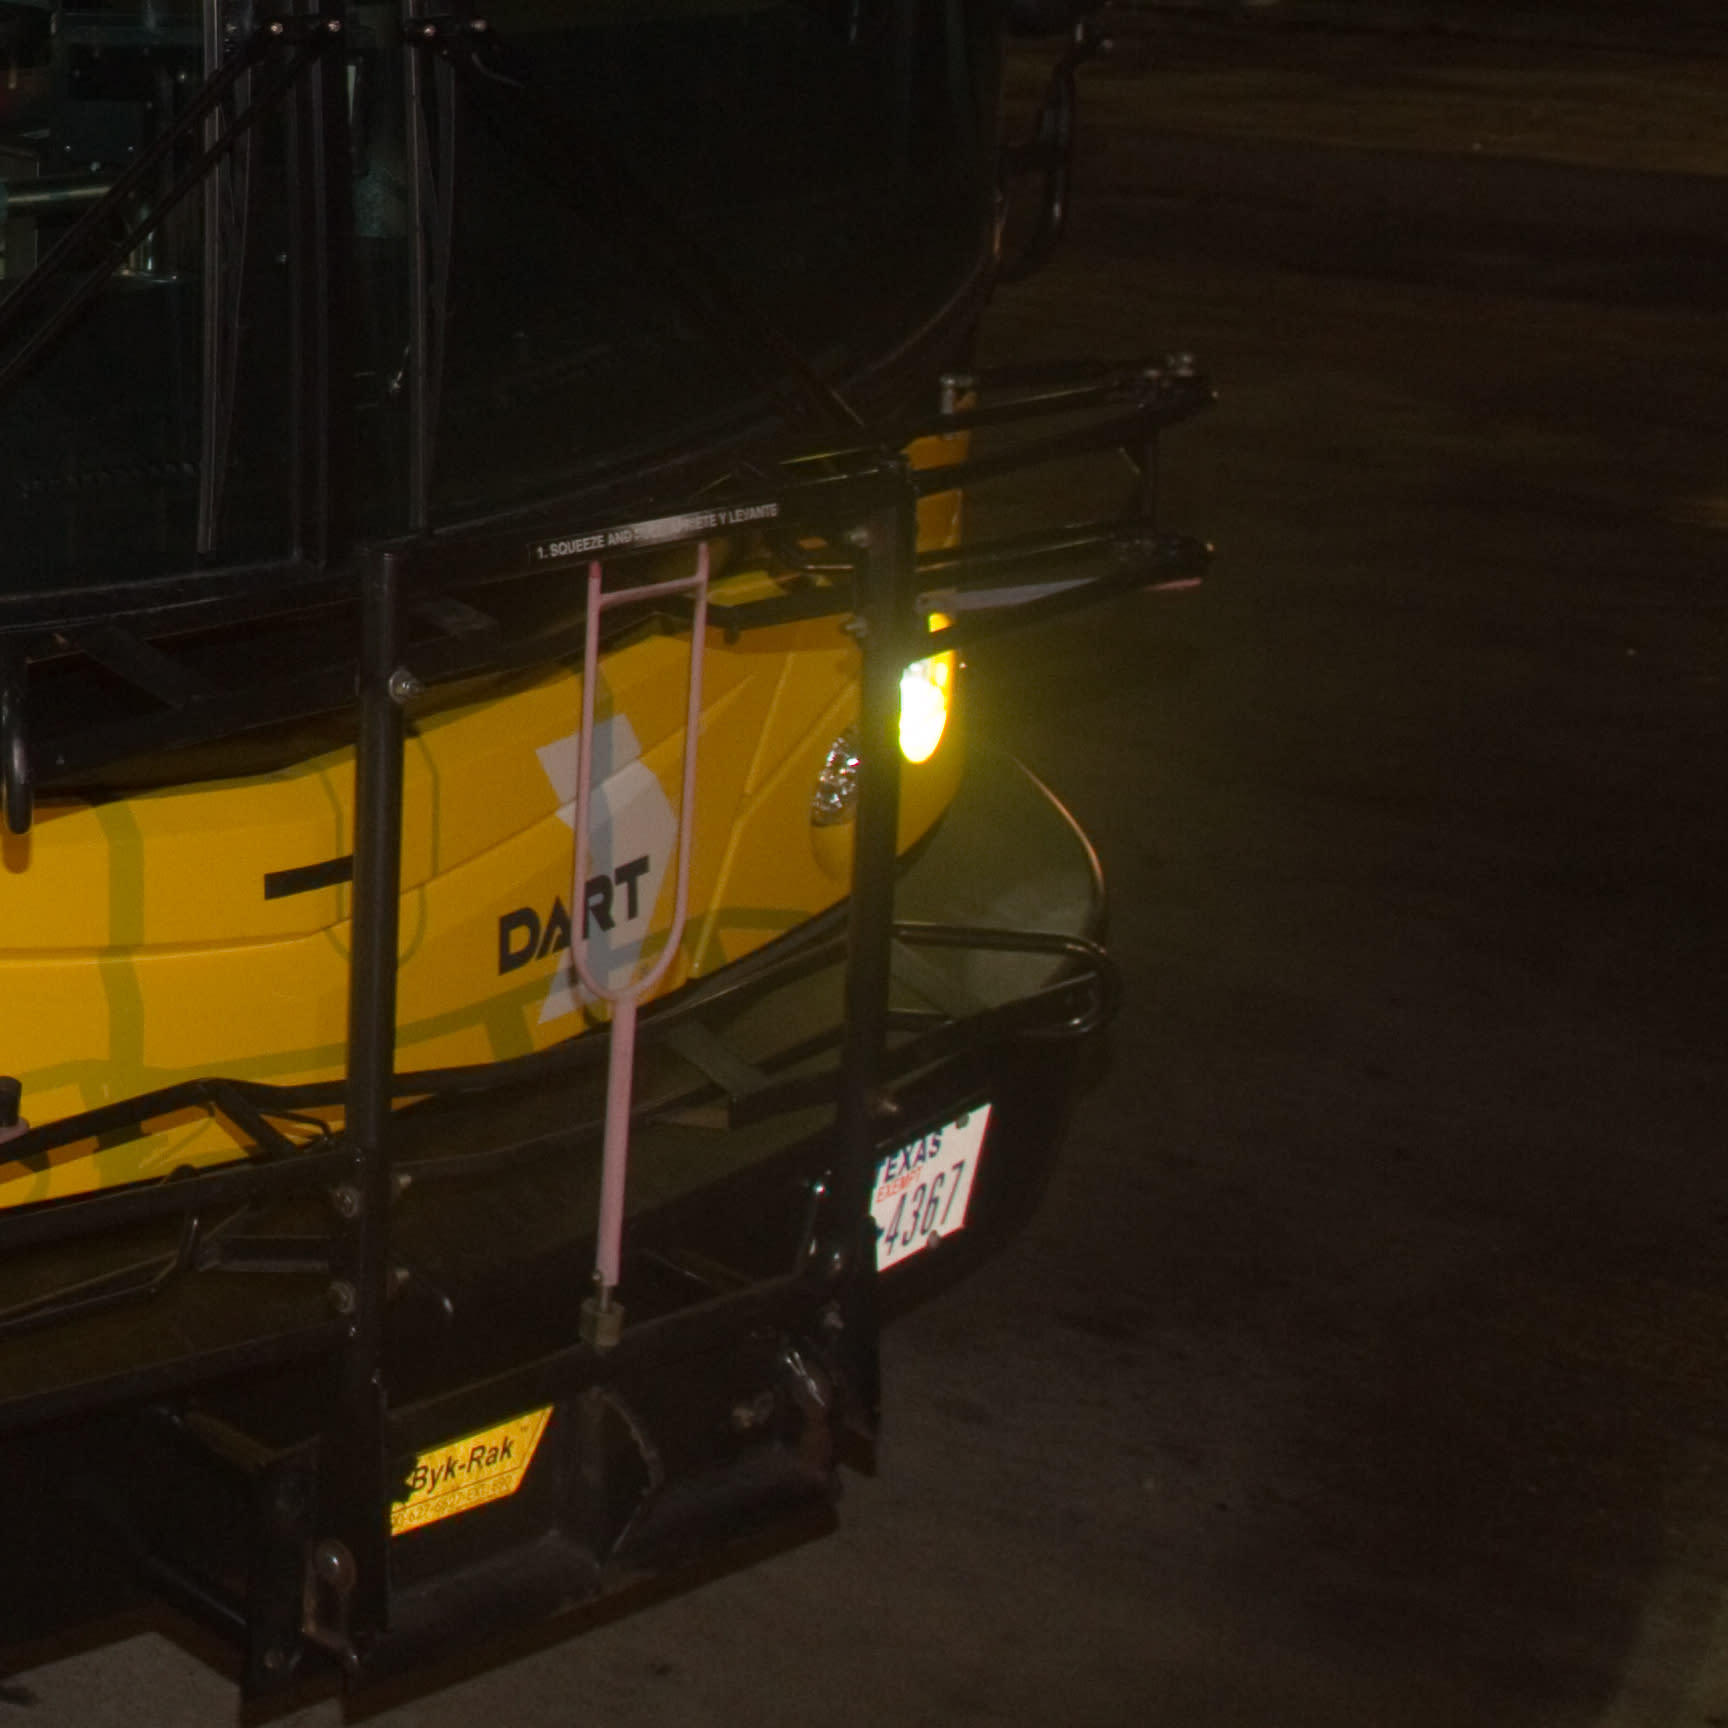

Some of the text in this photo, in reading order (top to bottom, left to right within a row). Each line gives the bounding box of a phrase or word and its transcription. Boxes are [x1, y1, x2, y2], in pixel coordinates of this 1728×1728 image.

[550, 534, 605, 557] SQUEEZE
[608, 528, 633, 546] AND
[498, 855, 650, 976] DART
[884, 1160, 965, 1256] 4367
[412, 1436, 515, 1494] Byk-Rak
